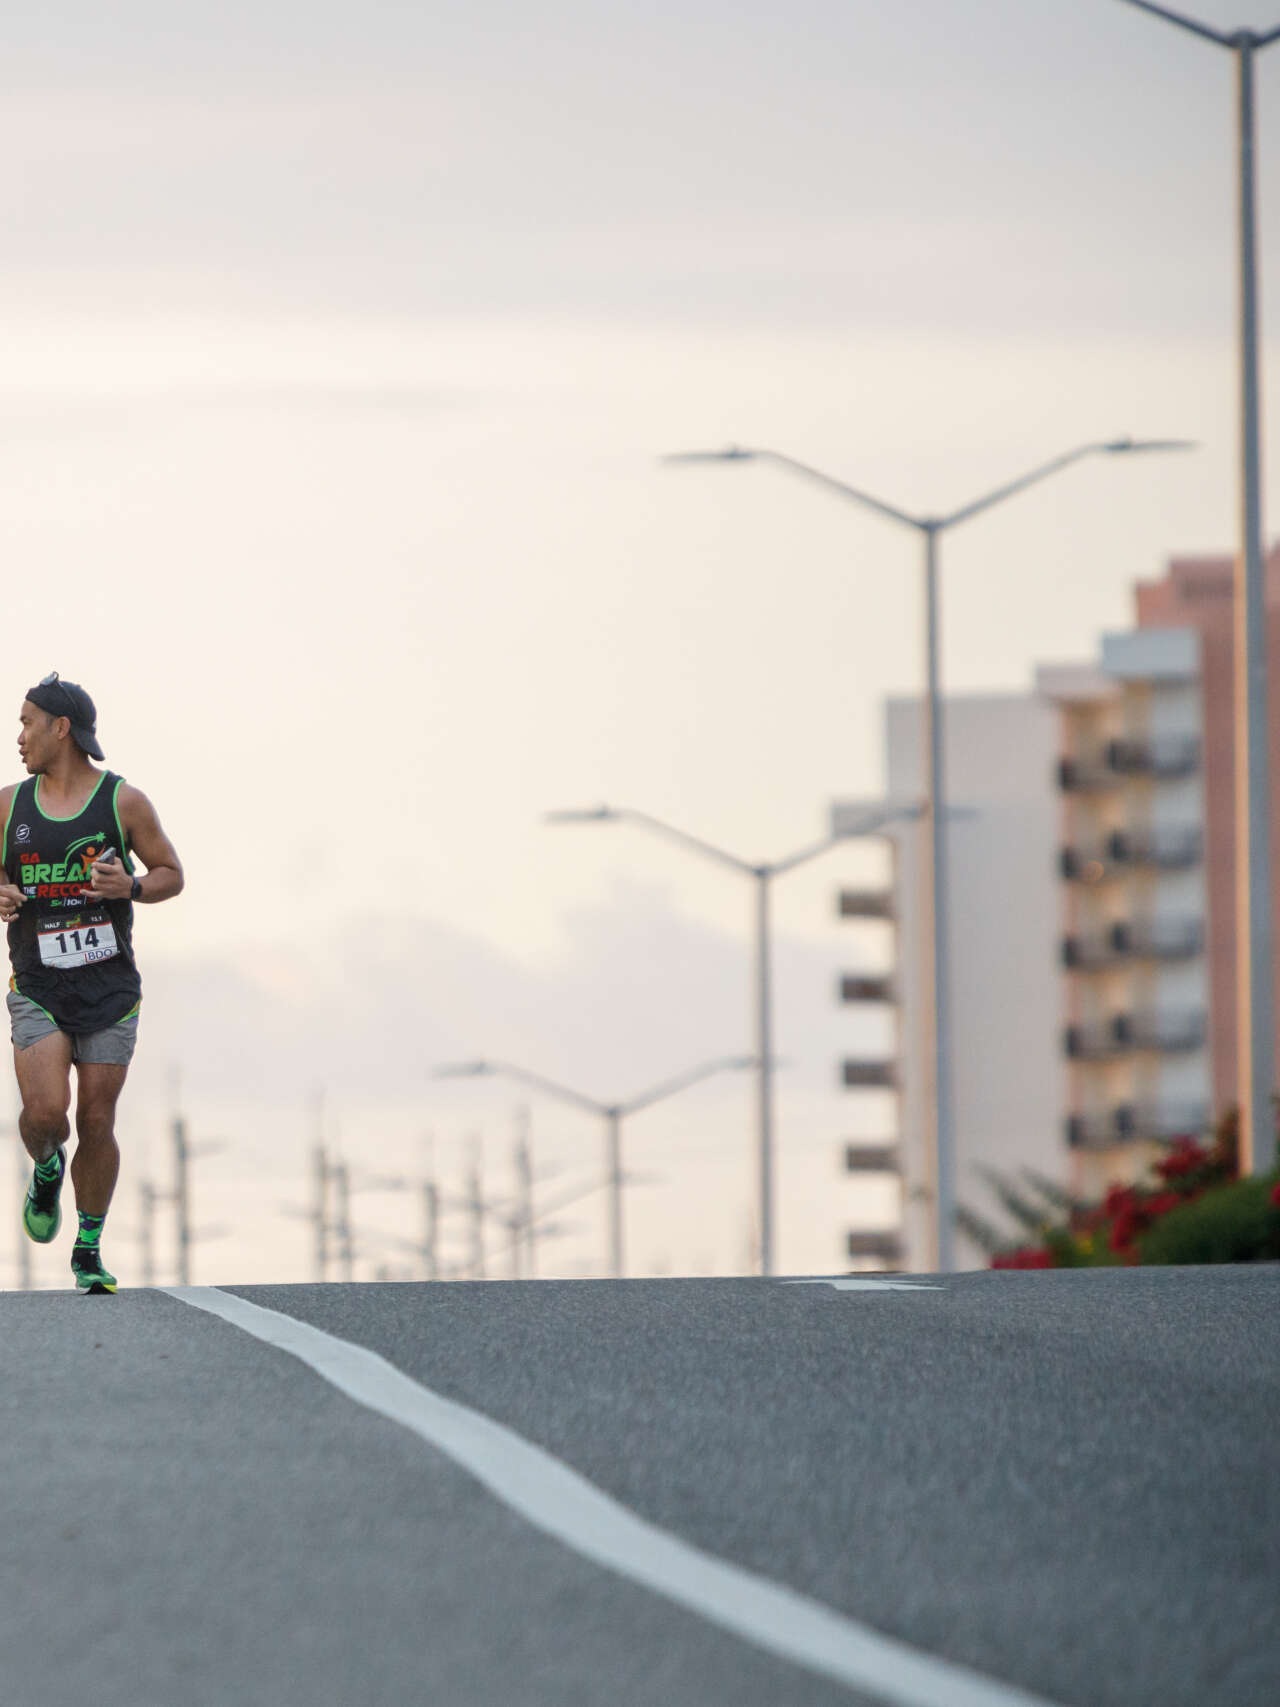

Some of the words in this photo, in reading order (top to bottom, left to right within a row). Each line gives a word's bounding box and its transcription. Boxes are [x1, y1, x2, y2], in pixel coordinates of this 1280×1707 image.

[23, 887, 36, 895] THE
[55, 928, 100, 953] 114
[87, 948, 113, 961] BDO
